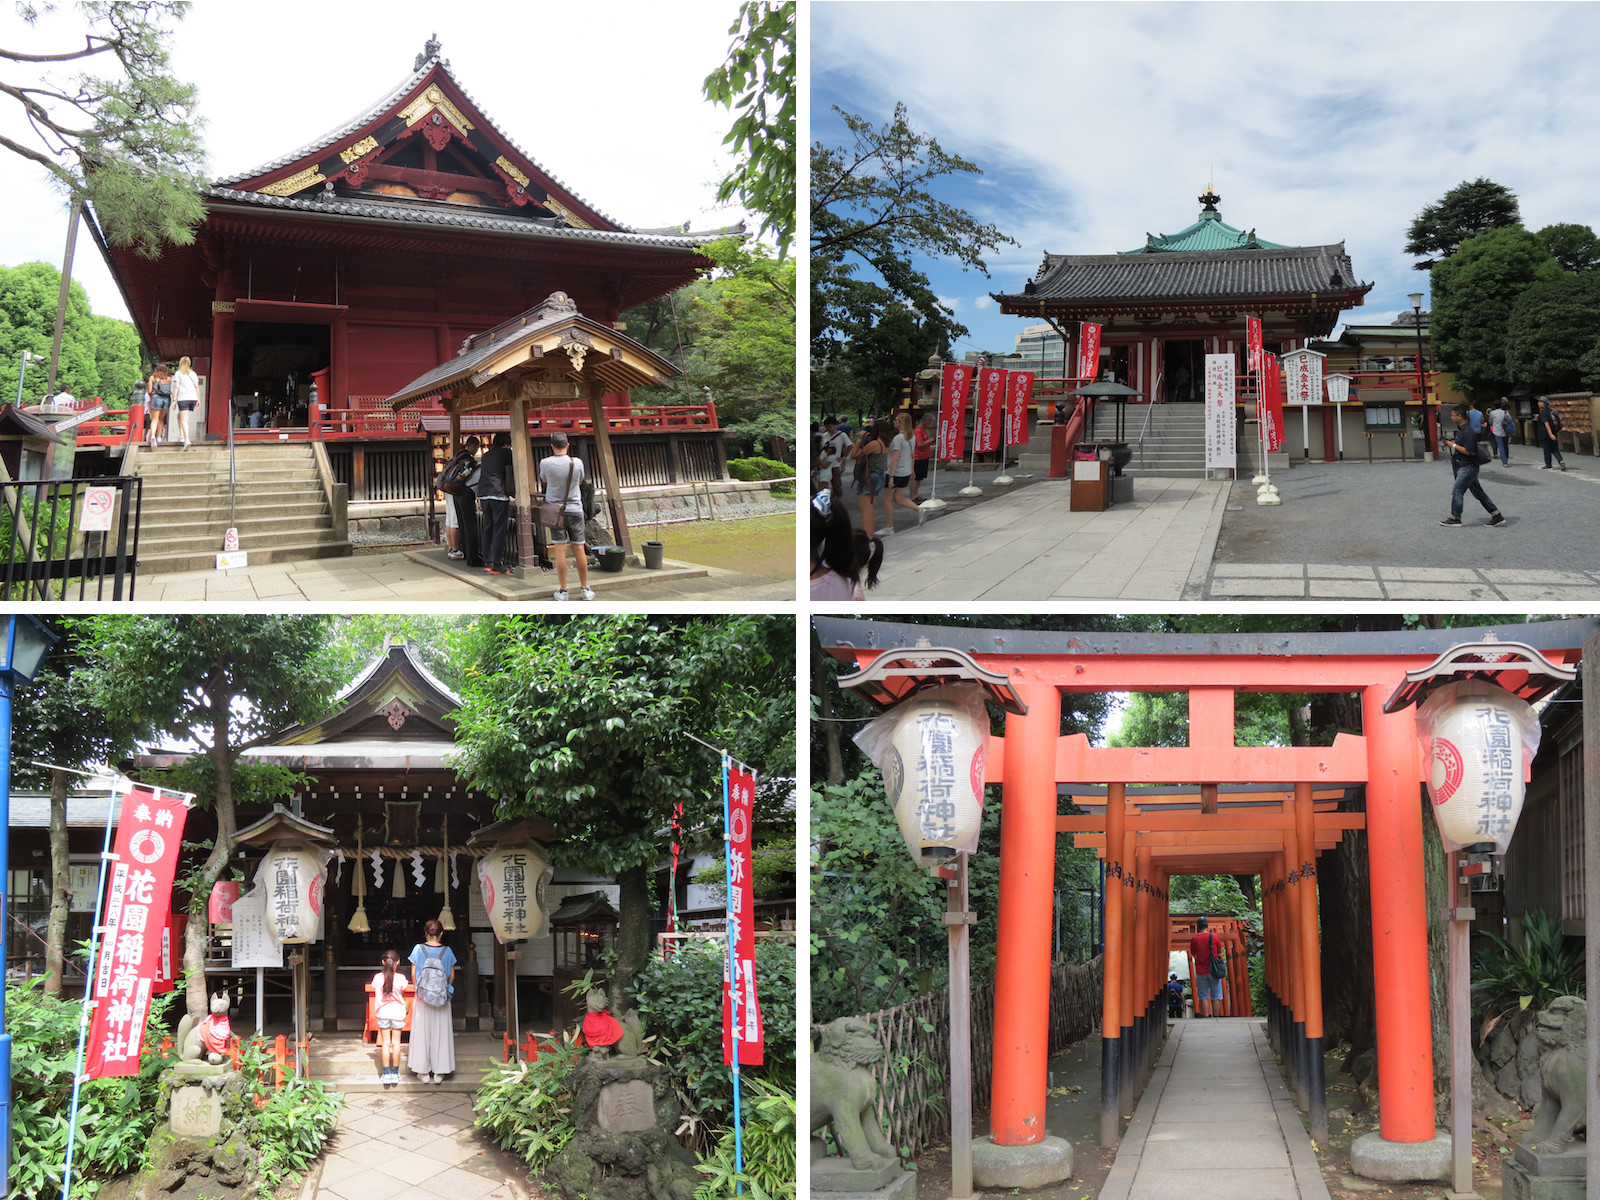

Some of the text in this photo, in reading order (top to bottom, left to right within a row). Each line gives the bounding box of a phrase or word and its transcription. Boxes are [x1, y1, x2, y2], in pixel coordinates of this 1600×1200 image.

[133, 803, 174, 829] 奉納
[1105, 860, 1122, 880] 納
[1287, 869, 1300, 886] 奉
[1299, 860, 1316, 881] 奉
[101, 868, 156, 1062] 花園稲荷神社
[183, 1096, 212, 1127] 納
